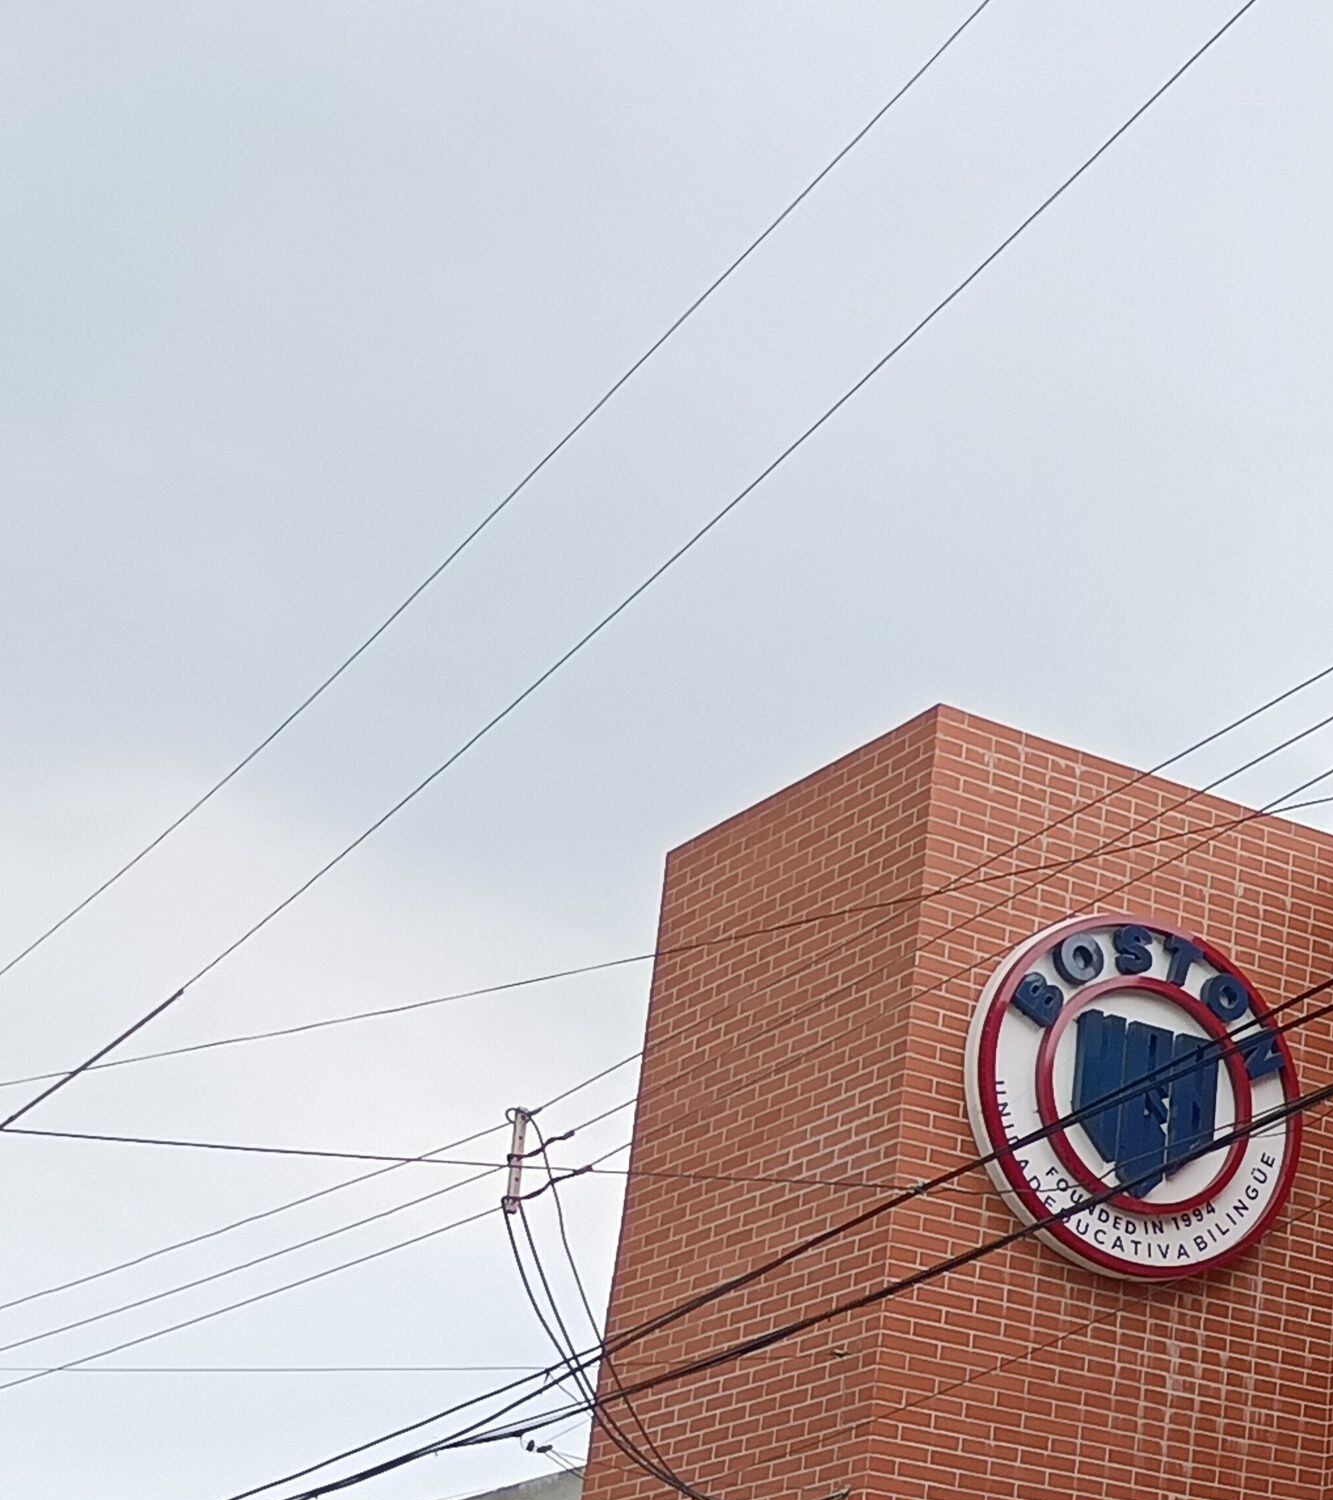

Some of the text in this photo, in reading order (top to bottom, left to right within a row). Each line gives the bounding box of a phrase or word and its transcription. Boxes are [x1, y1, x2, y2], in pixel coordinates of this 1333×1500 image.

[1012, 924, 1286, 1080] BOSTON
[1144, 1219, 1164, 1235] IN
[1171, 1201, 1216, 1231] 1994
[1193, 1151, 1276, 1253] BILINGÜE
